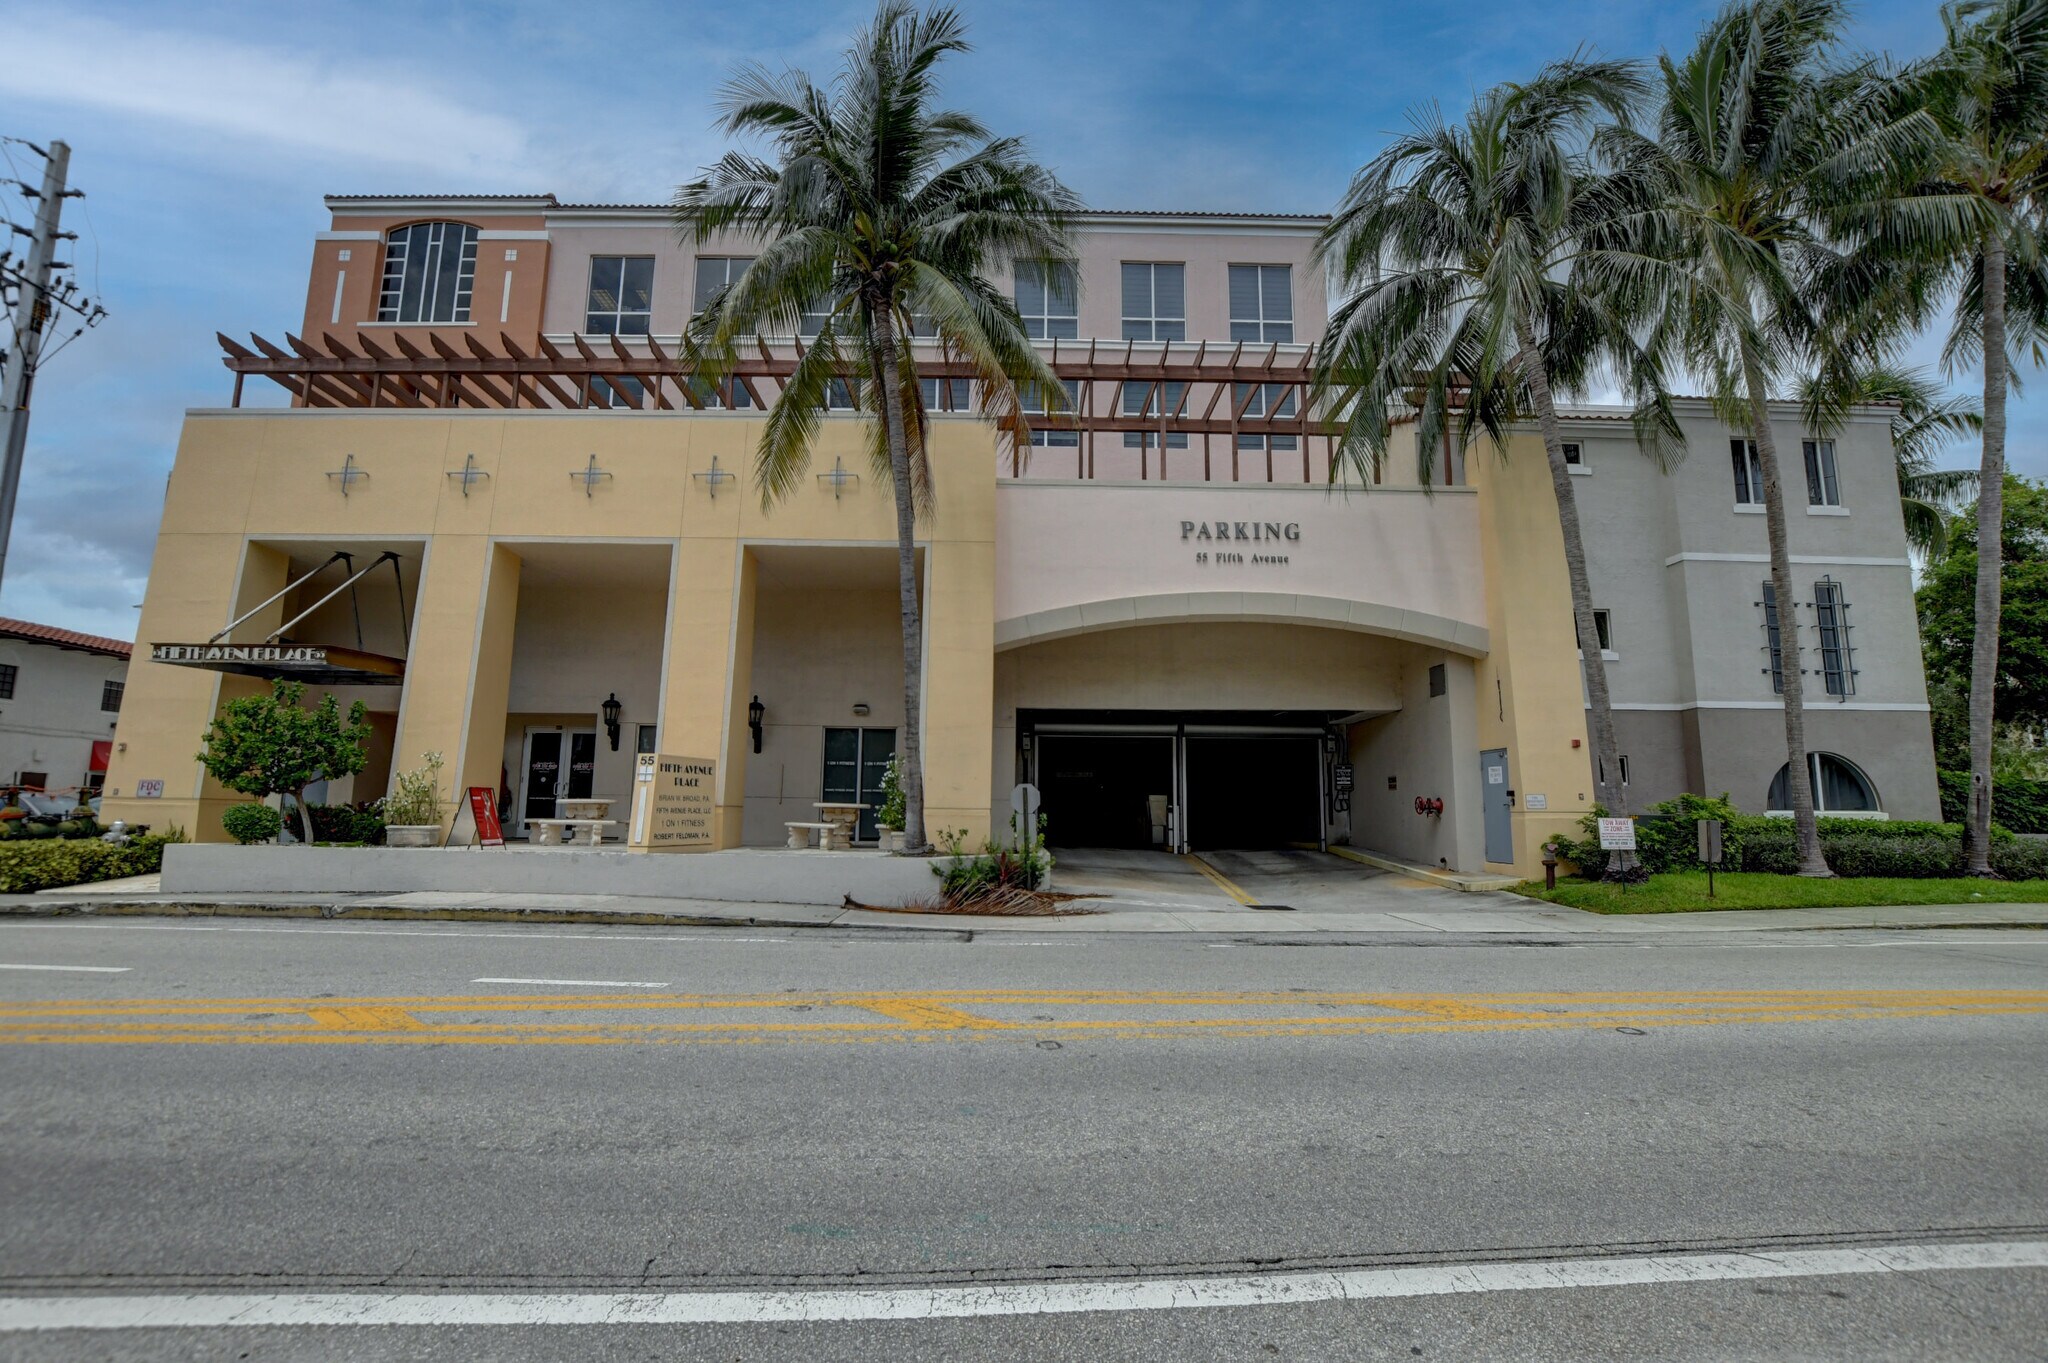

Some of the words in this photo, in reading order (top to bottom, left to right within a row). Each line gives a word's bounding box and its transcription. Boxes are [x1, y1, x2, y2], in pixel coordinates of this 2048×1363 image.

[1180, 520, 1300, 541] PARKING
[1196, 552, 1208, 563] 55
[1216, 552, 1244, 563] Fifth
[1251, 553, 1289, 563] Avenue
[160, 646, 205, 660] FIFTH
[206, 646, 264, 661] AVENUE
[264, 647, 316, 661] PLACE
[640, 755, 655, 766] 55
[660, 763, 682, 773] FIFTH
[685, 765, 713, 775] AVENUE
[141, 781, 161, 791] FDC
[674, 777, 699, 787] PLACE
